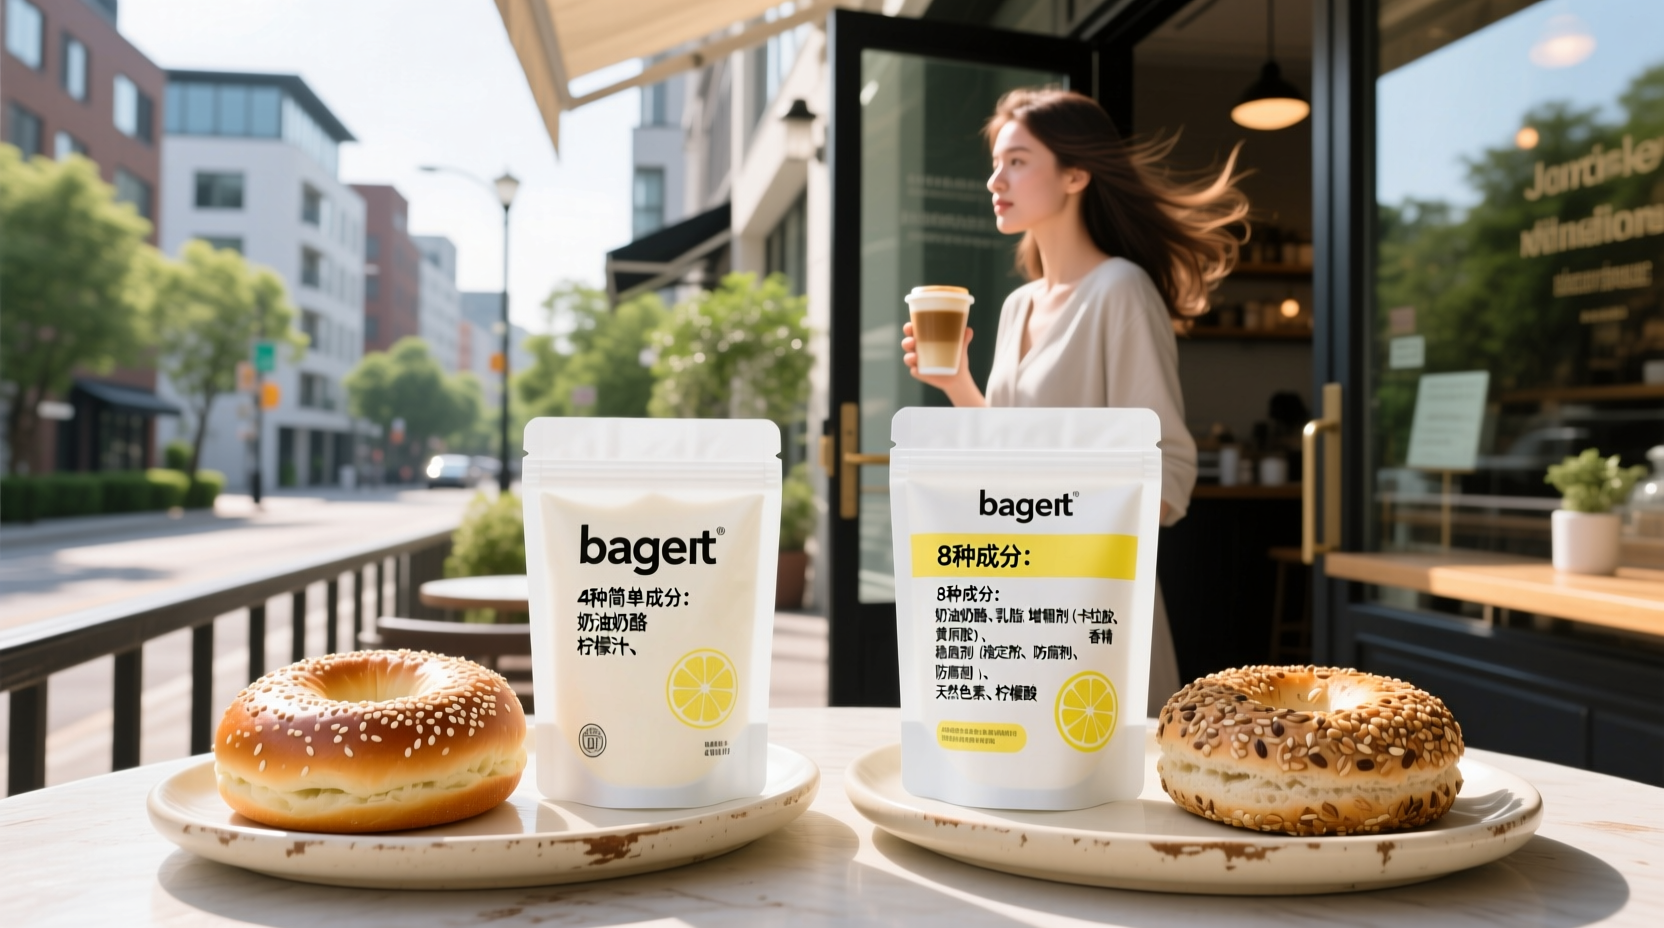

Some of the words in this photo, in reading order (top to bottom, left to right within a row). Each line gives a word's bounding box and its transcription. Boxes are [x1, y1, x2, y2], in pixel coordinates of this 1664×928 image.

[938, 544, 1029, 568] 8种成分：
[577, 587, 689, 608] 4种简单成分：
